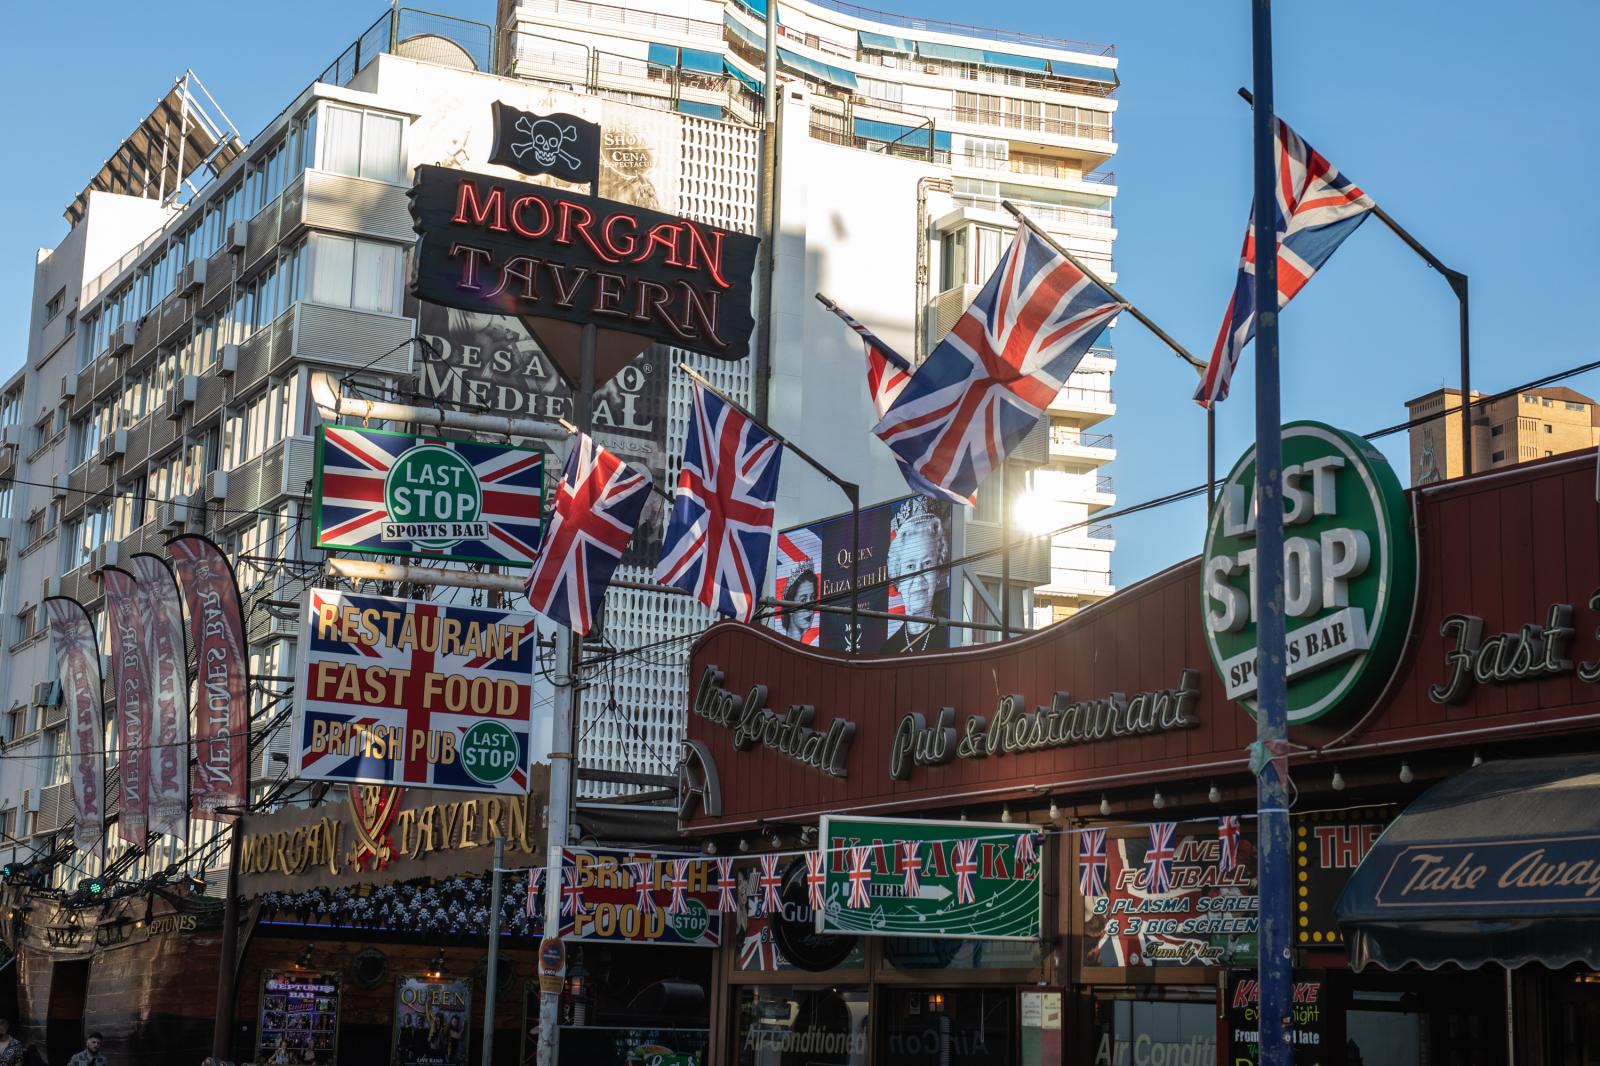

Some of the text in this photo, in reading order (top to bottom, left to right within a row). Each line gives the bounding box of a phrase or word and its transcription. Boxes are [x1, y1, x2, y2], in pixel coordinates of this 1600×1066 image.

[612, 151, 648, 162] CENA
[451, 179, 735, 288] MORGAN
[450, 242, 731, 348] TAVERN
[420, 334, 647, 393] DESAO
[417, 363, 653, 433] MEDIEAL
[406, 462, 465, 487] LAST
[393, 486, 476, 521] STOP
[1223, 455, 1345, 538] LST
[386, 522, 485, 538] SPORTS BAR
[823, 565, 888, 596] ELIZAETH II
[318, 603, 526, 663] RESTAURANT
[1305, 622, 1348, 657] BAR
[1429, 603, 1575, 704] Fast
[316, 660, 520, 717] FAST FOOD
[890, 668, 1200, 781] Pub & Restaurant
[311, 719, 457, 766] BRITISH PUB
[472, 731, 510, 748] LAST
[465, 748, 516, 769] STOP
[240, 797, 537, 876] MORGAN TAVERN
[1173, 839, 1222, 863] IVE
[1116, 864, 1251, 891] FOTBALL
[1401, 852, 1487, 897] Take
[870, 884, 910, 898] HER
[681, 906, 704, 917] AST
[1093, 896, 1259, 914] 8 PLASMA SCREE
[144, 914, 198, 937] NEPTUNES
[675, 917, 707, 931] STOP
[1124, 917, 1143, 935] 3
[1146, 918, 1179, 934] BIG
[1143, 940, 1196, 963] Family
[1197, 941, 1225, 959] bar
[269, 982, 336, 994] NEPTUNES
[288, 991, 315, 999] BAR
[401, 988, 466, 1014] QUEEN
[770, 1025, 867, 1055] Conditioned
[1095, 1032, 1130, 1066] Air
[1299, 1030, 1320, 1044] late
